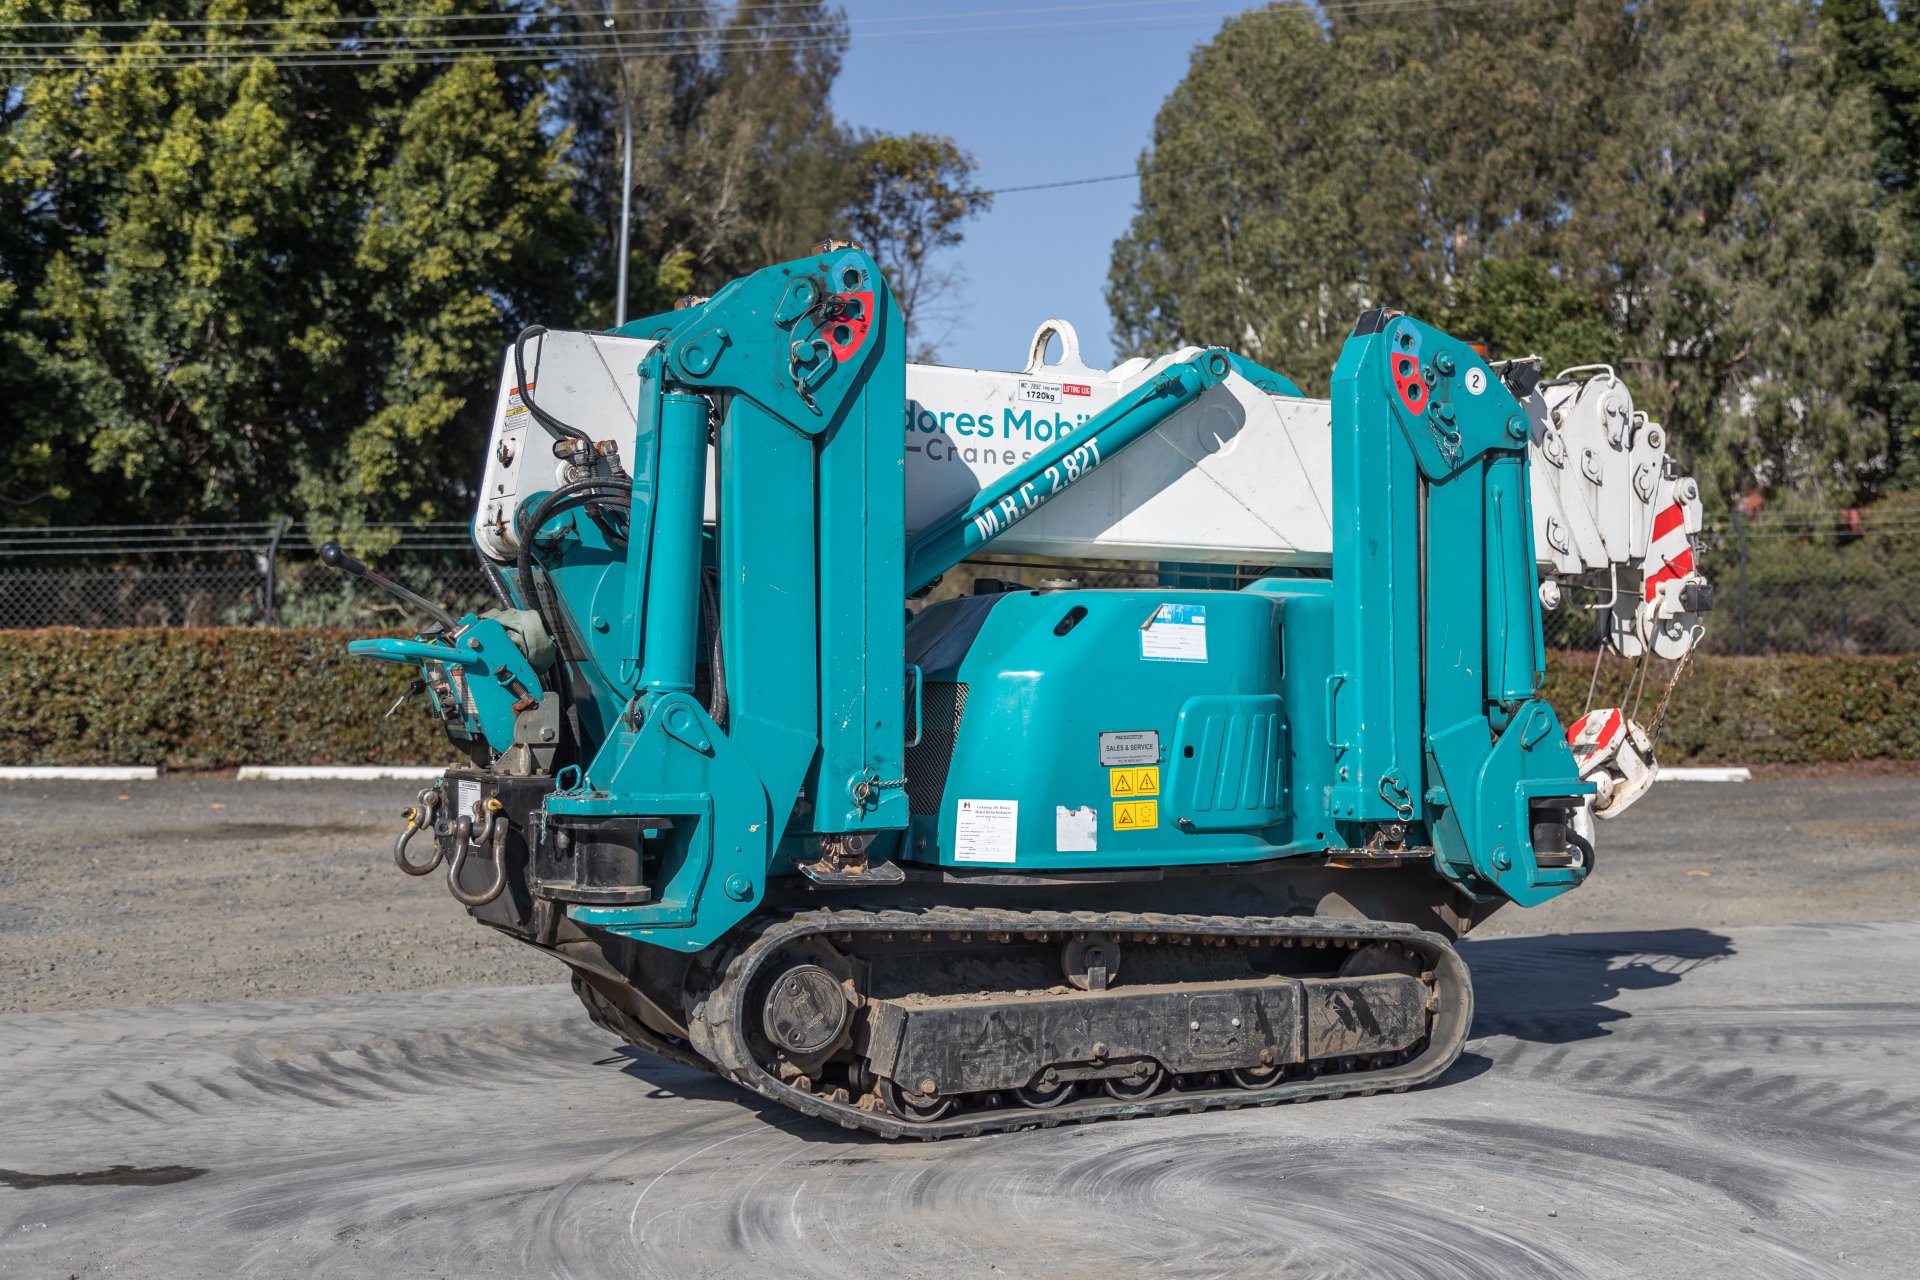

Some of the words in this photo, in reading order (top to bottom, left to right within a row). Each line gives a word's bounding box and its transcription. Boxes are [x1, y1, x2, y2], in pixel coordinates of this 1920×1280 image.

[1472, 374, 1480, 389] 2
[1026, 391, 1055, 402] 1720kg
[1063, 385, 1081, 394] LIFTING
[1081, 387, 1091, 395] LUG
[926, 438, 1032, 466] Cranes
[972, 482, 1046, 541] M.R.C.
[1044, 437, 1102, 496] 2.82T
[1106, 744, 1124, 752] SALES
[1130, 743, 1154, 751] SERVICE
